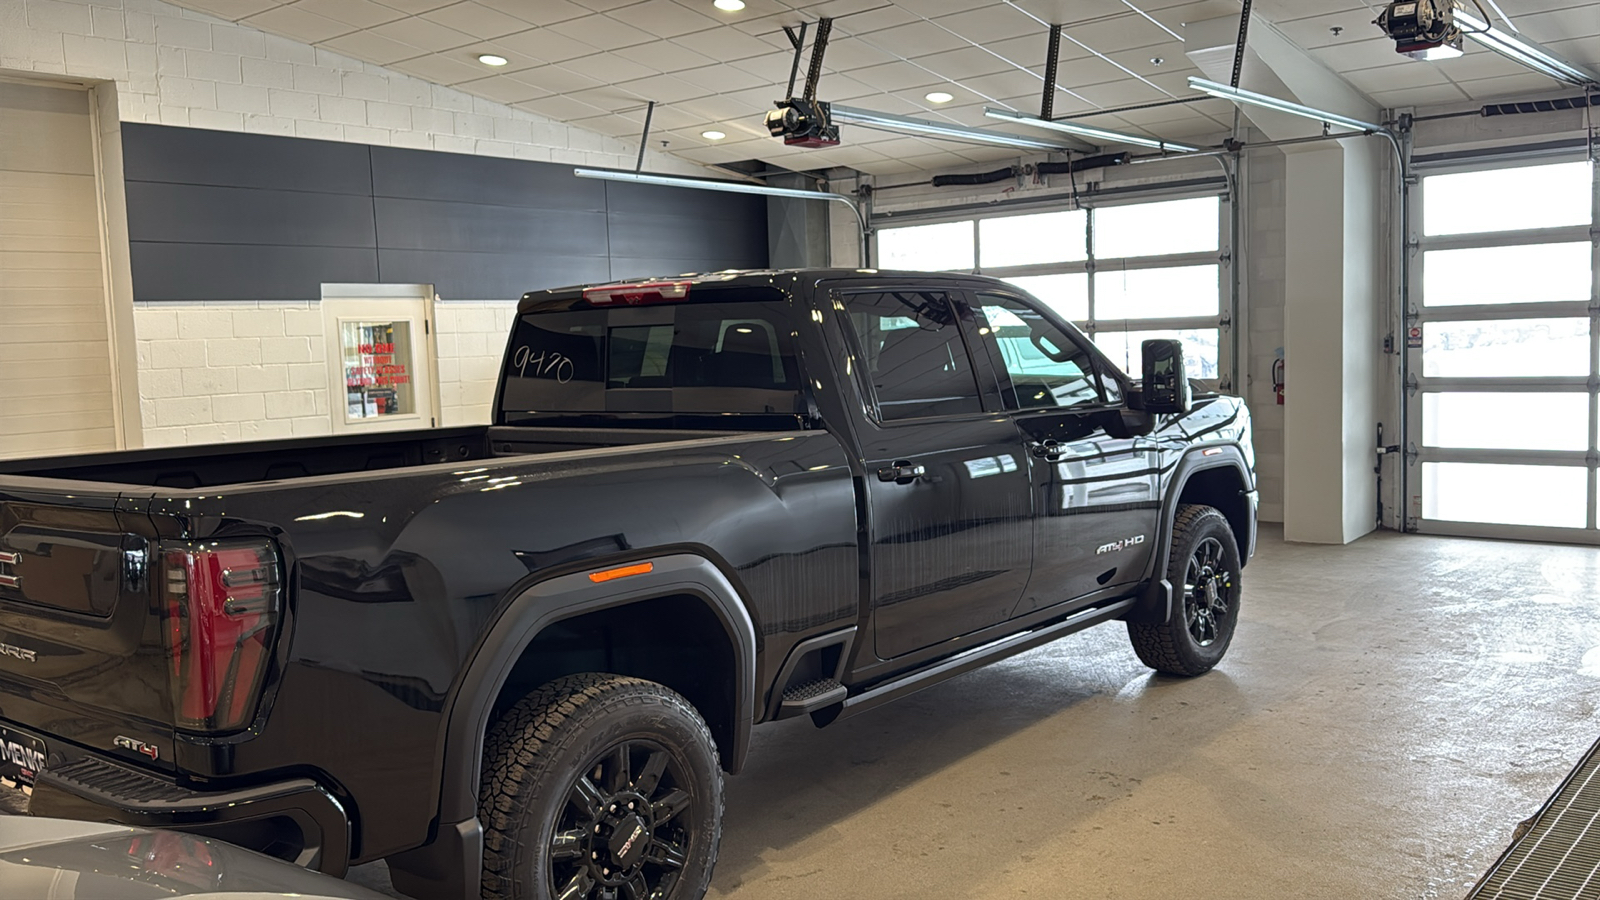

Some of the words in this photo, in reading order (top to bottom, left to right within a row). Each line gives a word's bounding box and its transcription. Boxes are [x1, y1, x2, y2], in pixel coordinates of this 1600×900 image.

[358, 344, 372, 354] NO
[375, 343, 395, 353] ONE
[364, 356, 391, 364] WITHOUT
[514, 345, 574, 384] 9470
[351, 366, 375, 375] SAFETY
[376, 365, 405, 374] GLASSES
[347, 377, 372, 386] BEYOND
[1096, 541, 1123, 555] AT4
[1125, 535, 1145, 547] HD
[113, 735, 158, 760] AT4
